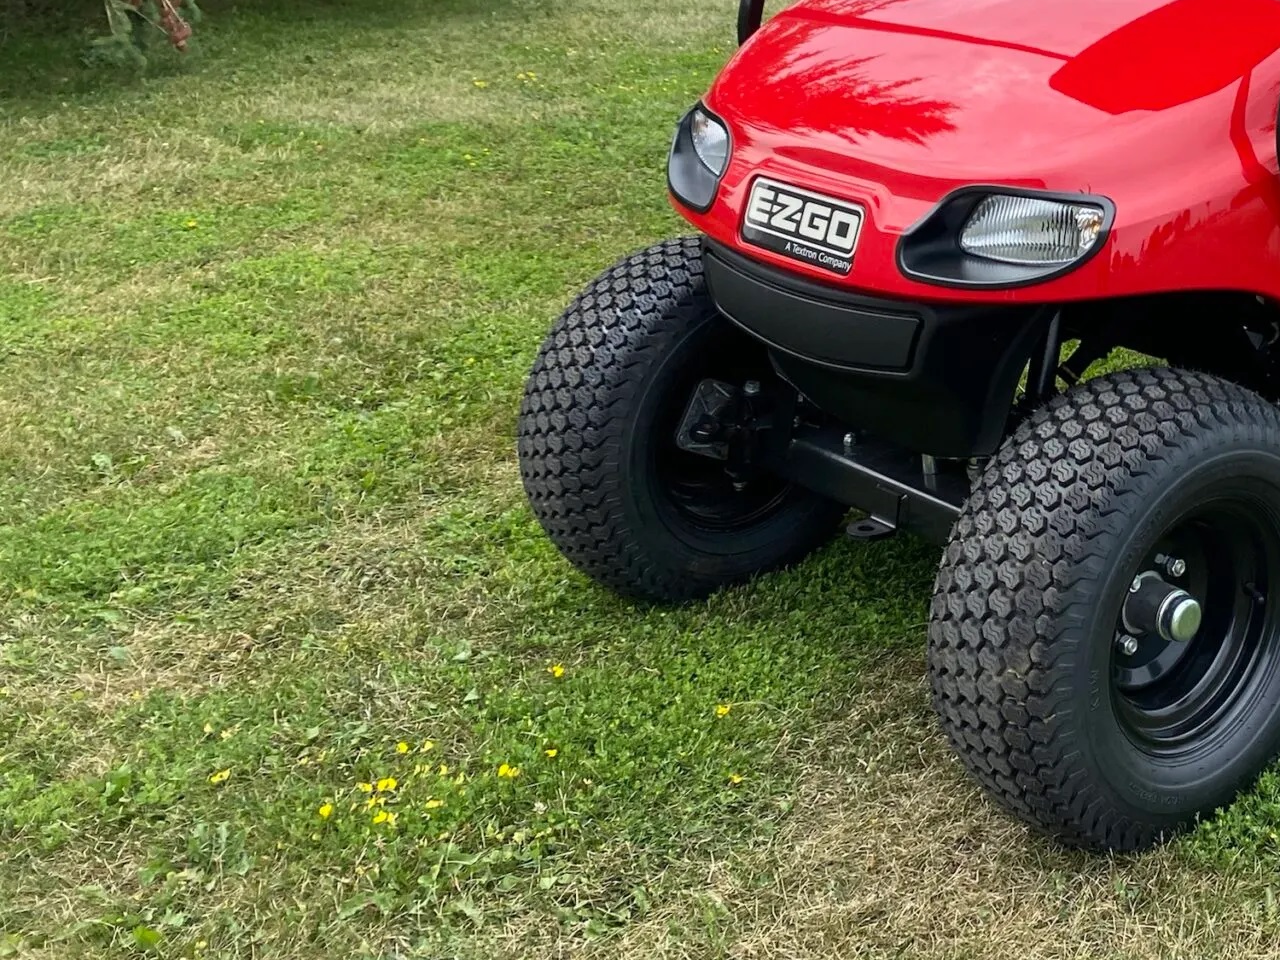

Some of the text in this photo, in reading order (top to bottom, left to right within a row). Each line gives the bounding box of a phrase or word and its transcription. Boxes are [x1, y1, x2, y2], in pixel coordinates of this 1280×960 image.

[748, 186, 860, 250] EZGO
[785, 241, 852, 272] A Textron Company
